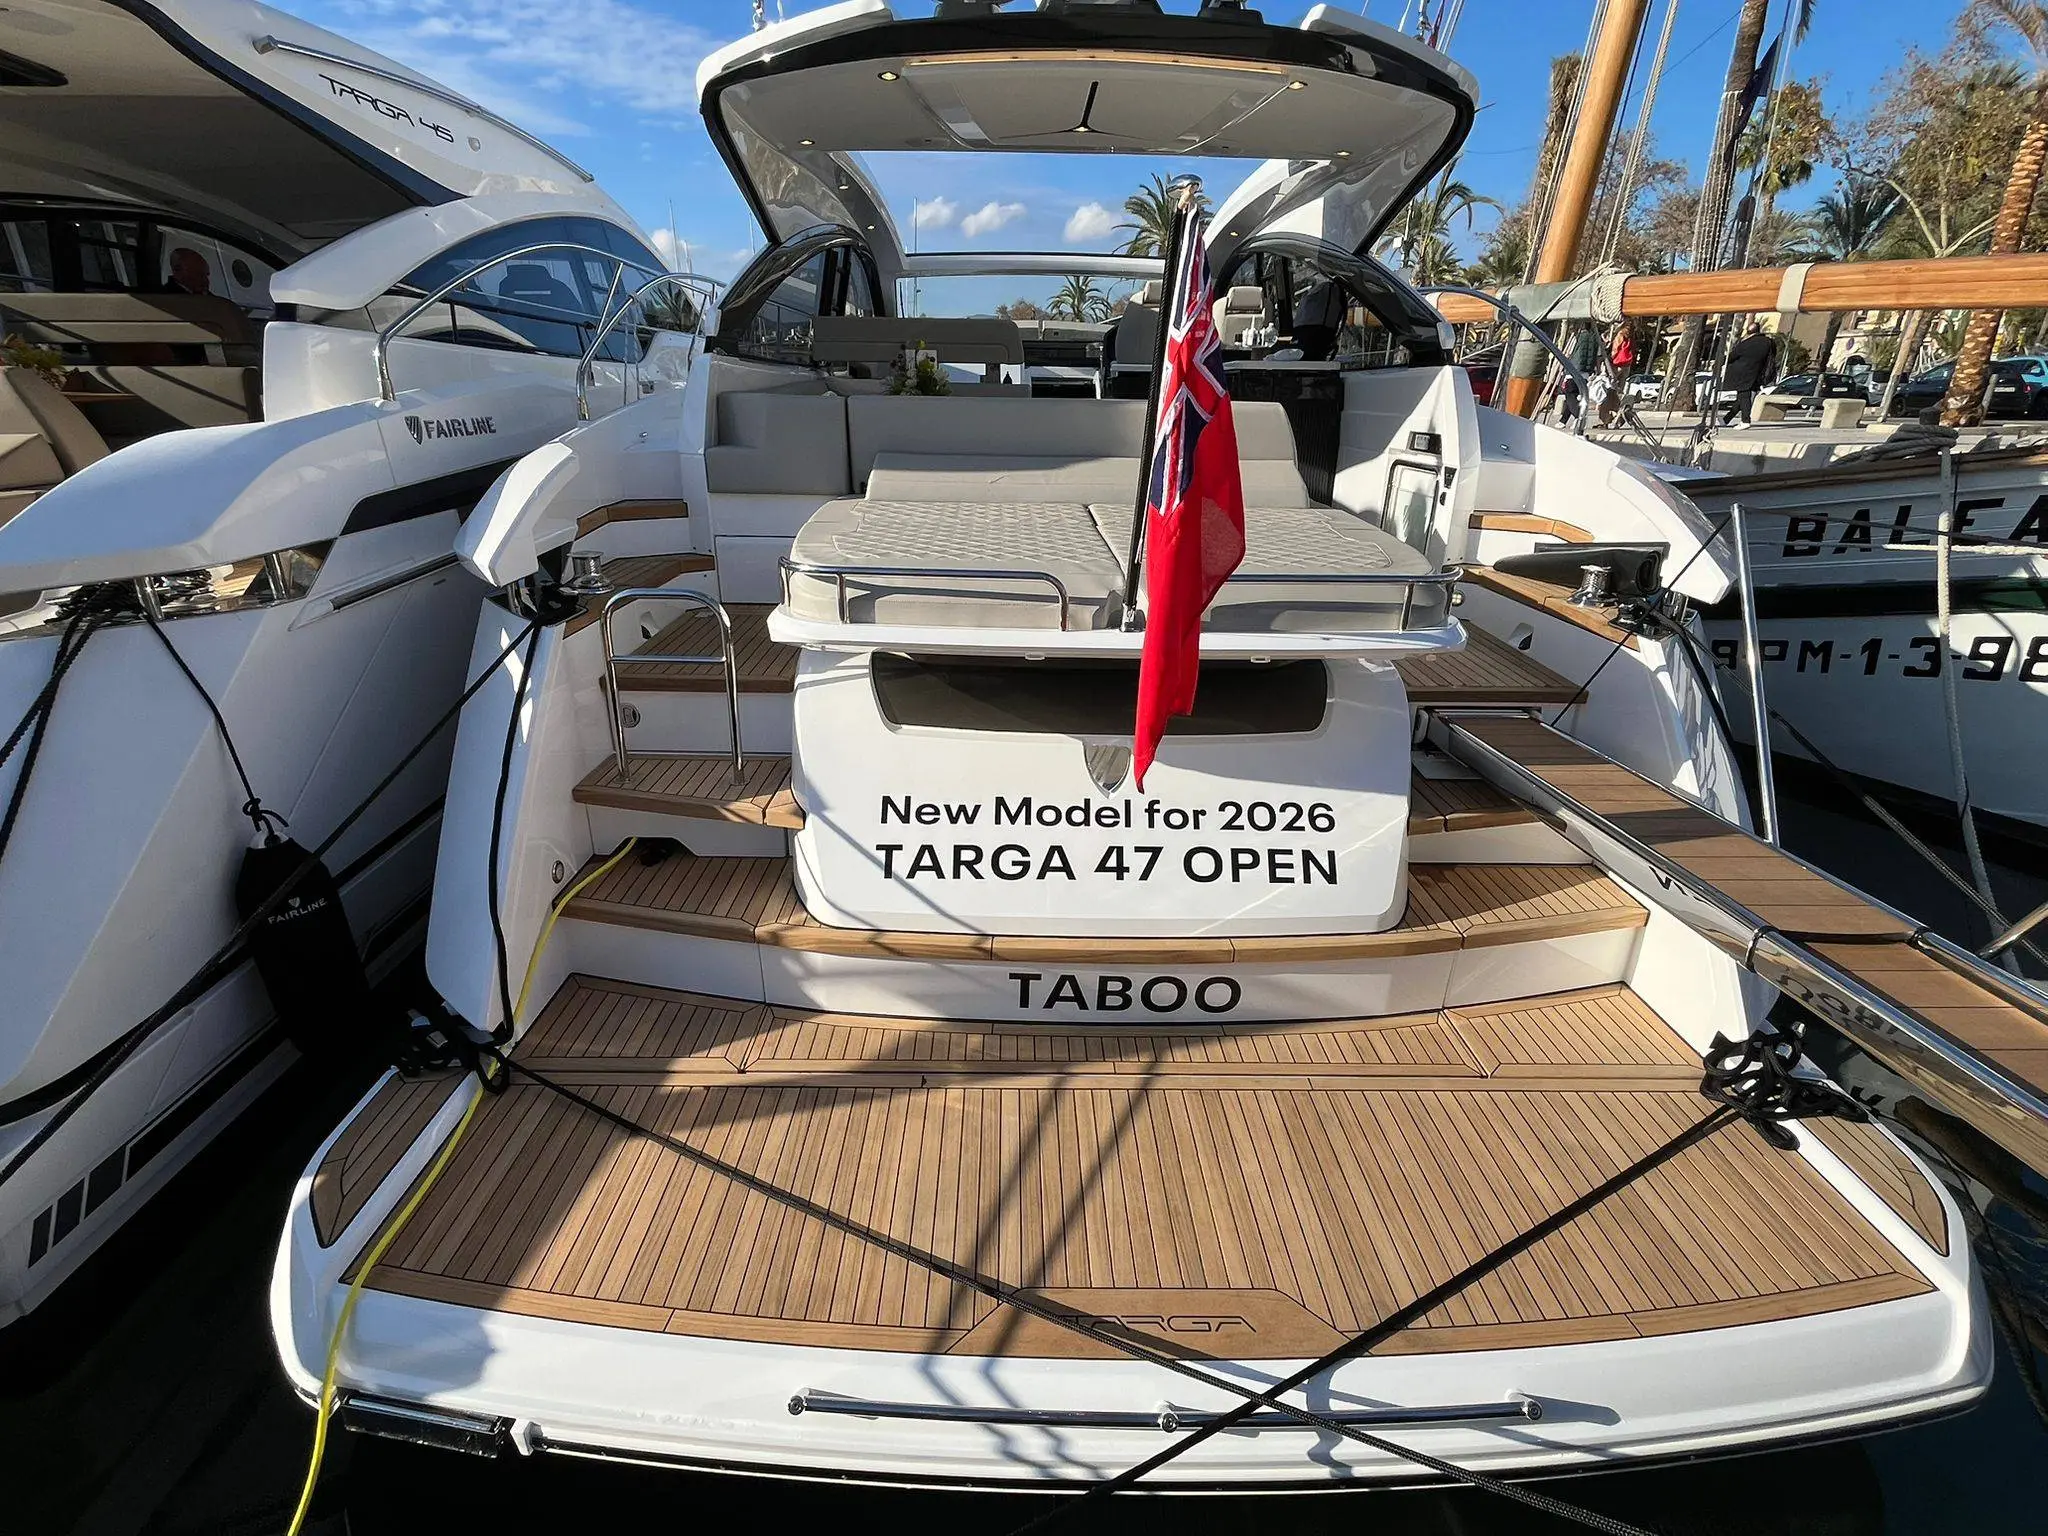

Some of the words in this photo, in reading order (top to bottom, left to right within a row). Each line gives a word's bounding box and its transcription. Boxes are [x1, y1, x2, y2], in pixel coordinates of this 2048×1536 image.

[319, 74, 415, 127] TARGA
[423, 416, 497, 440] FAIRLINE
[880, 795, 982, 825] New
[994, 796, 1132, 828] Model
[1144, 800, 1207, 830] for
[1218, 801, 1336, 833] 2026
[875, 843, 1077, 881] TARGA
[1093, 845, 1164, 881] 47
[1183, 846, 1338, 885] OPEN
[267, 897, 328, 924] FAIRLINE
[1009, 972, 1241, 1013] TABOO
